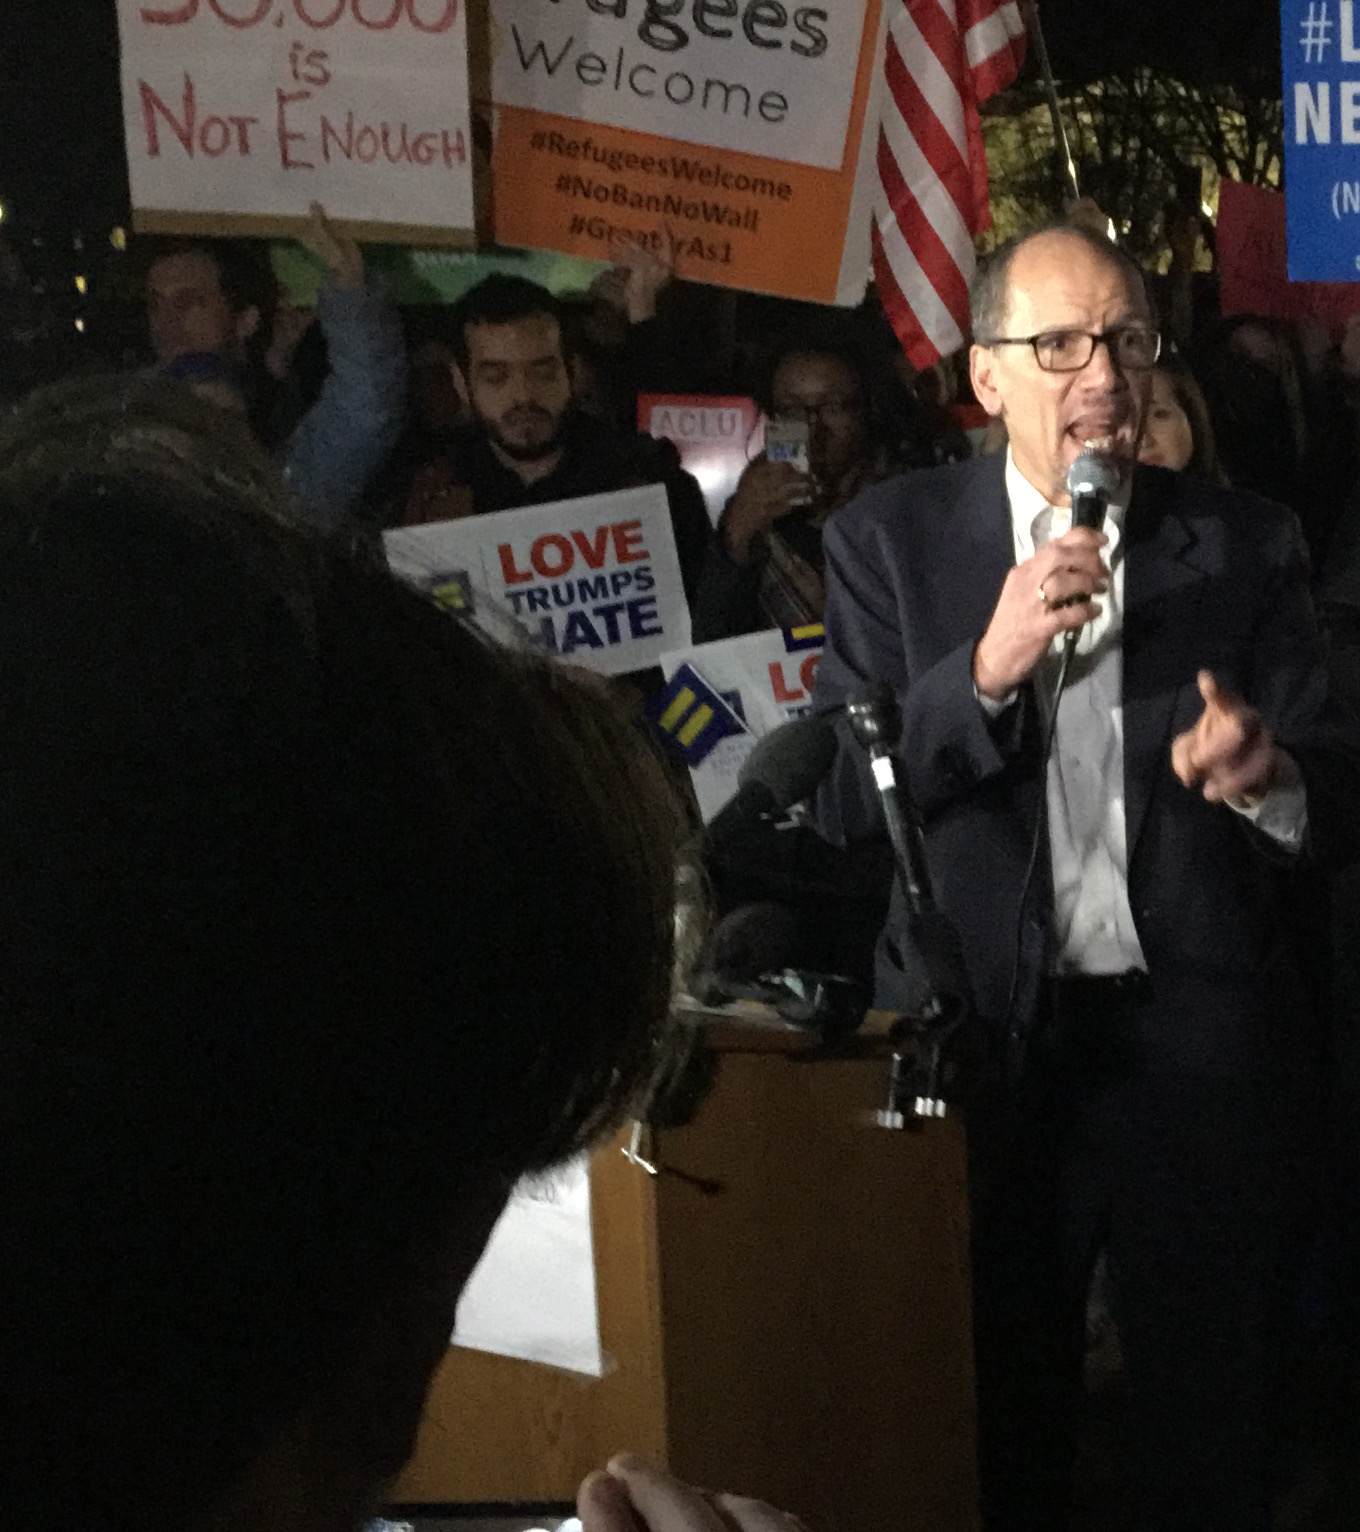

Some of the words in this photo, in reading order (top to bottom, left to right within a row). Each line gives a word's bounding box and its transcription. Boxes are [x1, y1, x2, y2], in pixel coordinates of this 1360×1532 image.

[288, 40, 332, 87] is
[511, 23, 789, 123] Welcome
[275, 87, 467, 172] ENOUGH
[529, 130, 793, 202] #RefugeesWelcome
[555, 173, 759, 233] #NoBanNoWall
[497, 518, 652, 586] LOVE
[504, 565, 656, 616] TRUMPS
